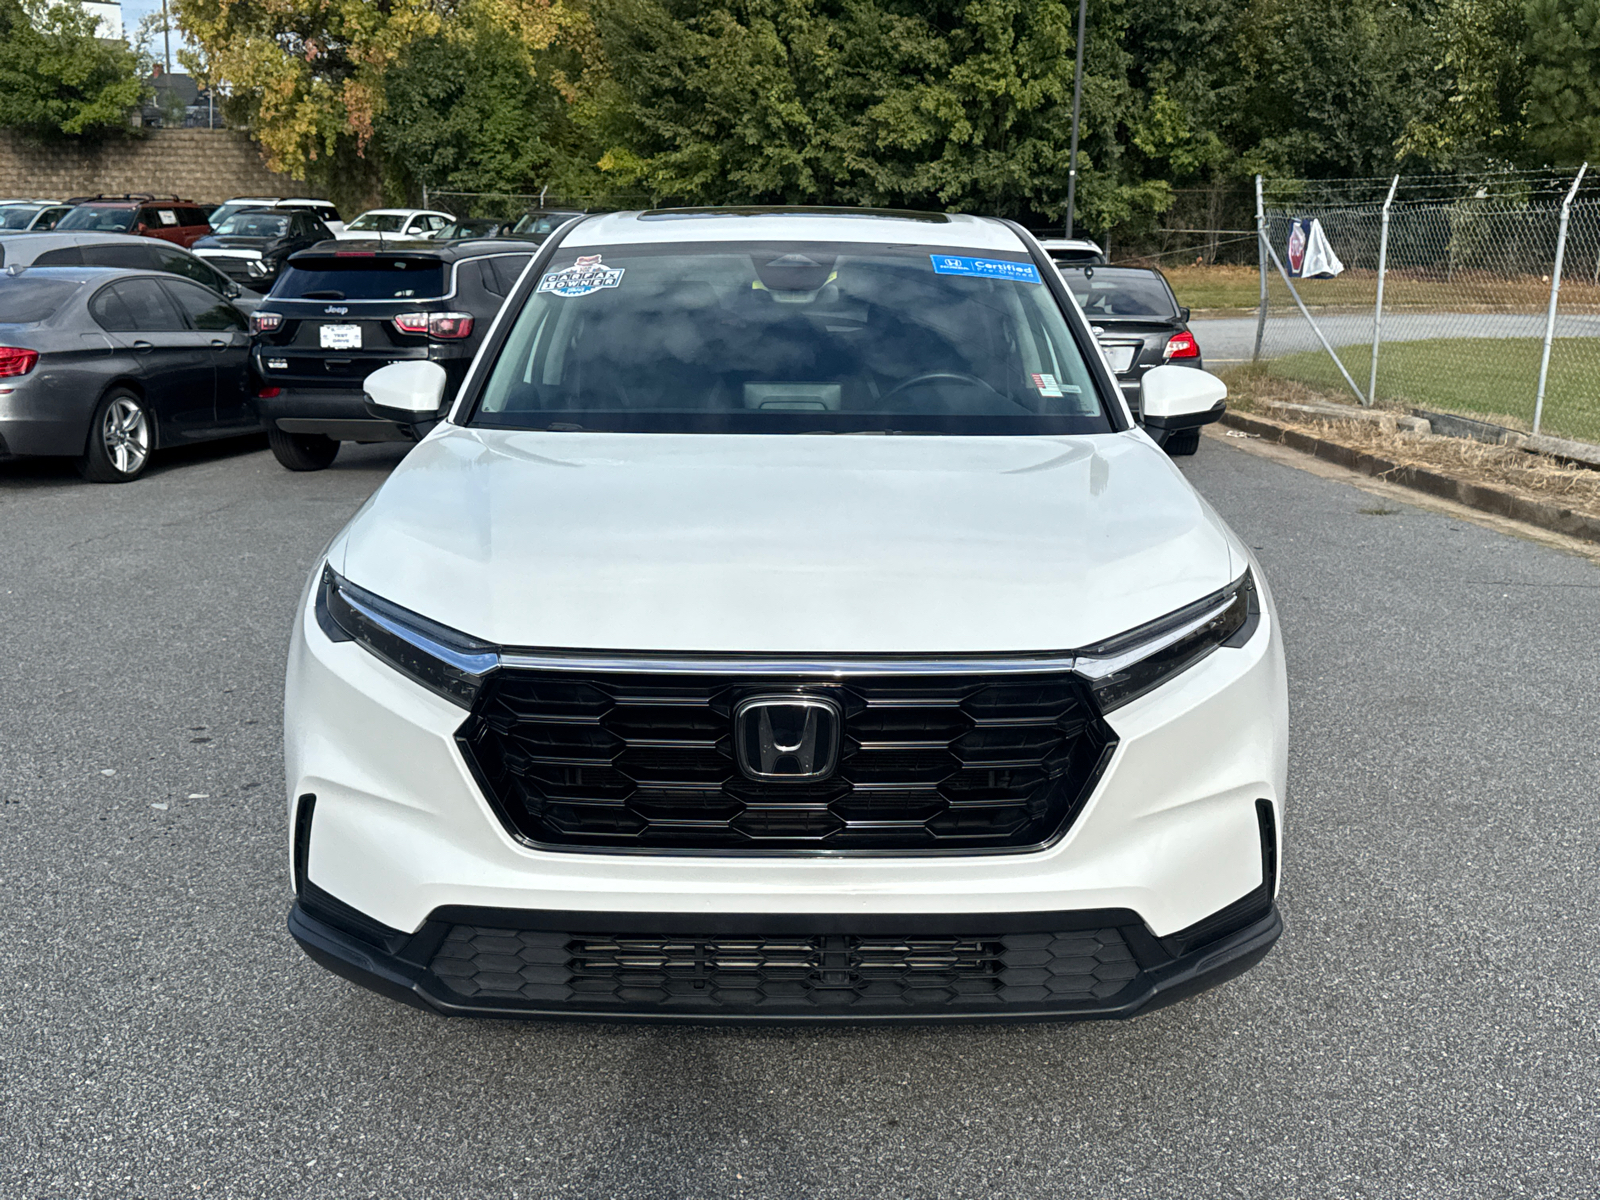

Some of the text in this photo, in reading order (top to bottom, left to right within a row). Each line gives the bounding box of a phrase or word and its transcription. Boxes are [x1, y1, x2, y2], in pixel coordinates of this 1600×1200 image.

[974, 261, 1032, 273] Certified
[977, 267, 1034, 278] Pre-Owned
[546, 271, 618, 283] CARFAX
[543, 278, 616, 291] 1 OWNER
[324, 305, 348, 315] Jeep
